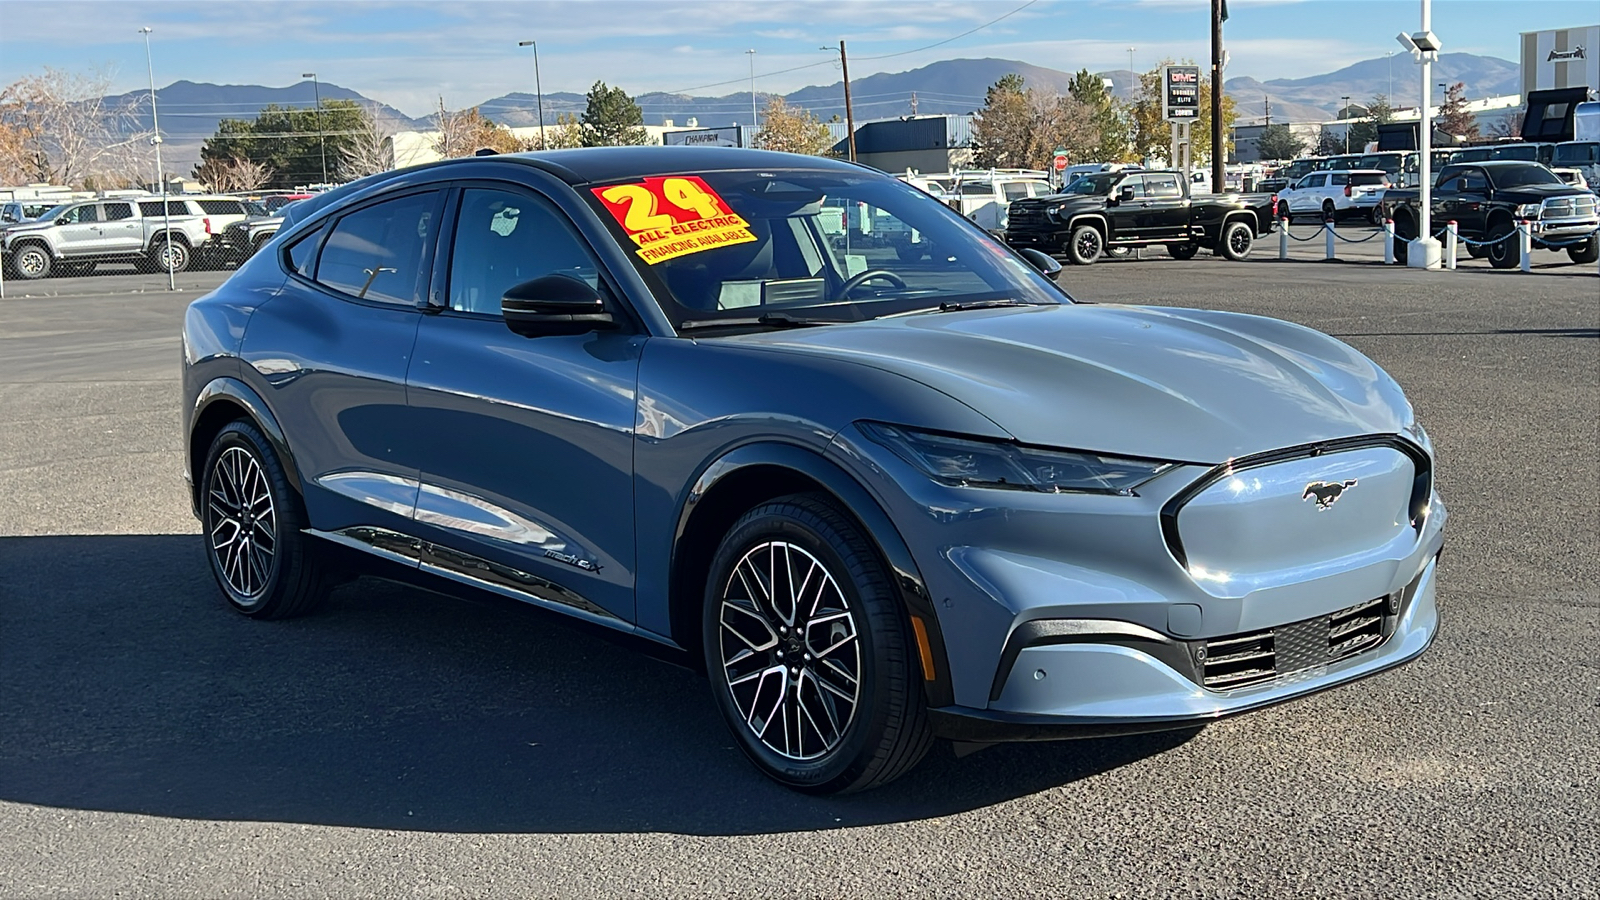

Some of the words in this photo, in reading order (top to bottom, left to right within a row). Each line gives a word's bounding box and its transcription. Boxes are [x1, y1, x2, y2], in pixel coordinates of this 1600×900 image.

[1171, 73, 1197, 82] GMC
[684, 133, 719, 146] CHAMPION
[601, 178, 721, 232] 24
[638, 215, 742, 246] ALL-ELECTRIC
[641, 238, 698, 261] FINANCING
[699, 229, 751, 248] AVAILABLE
